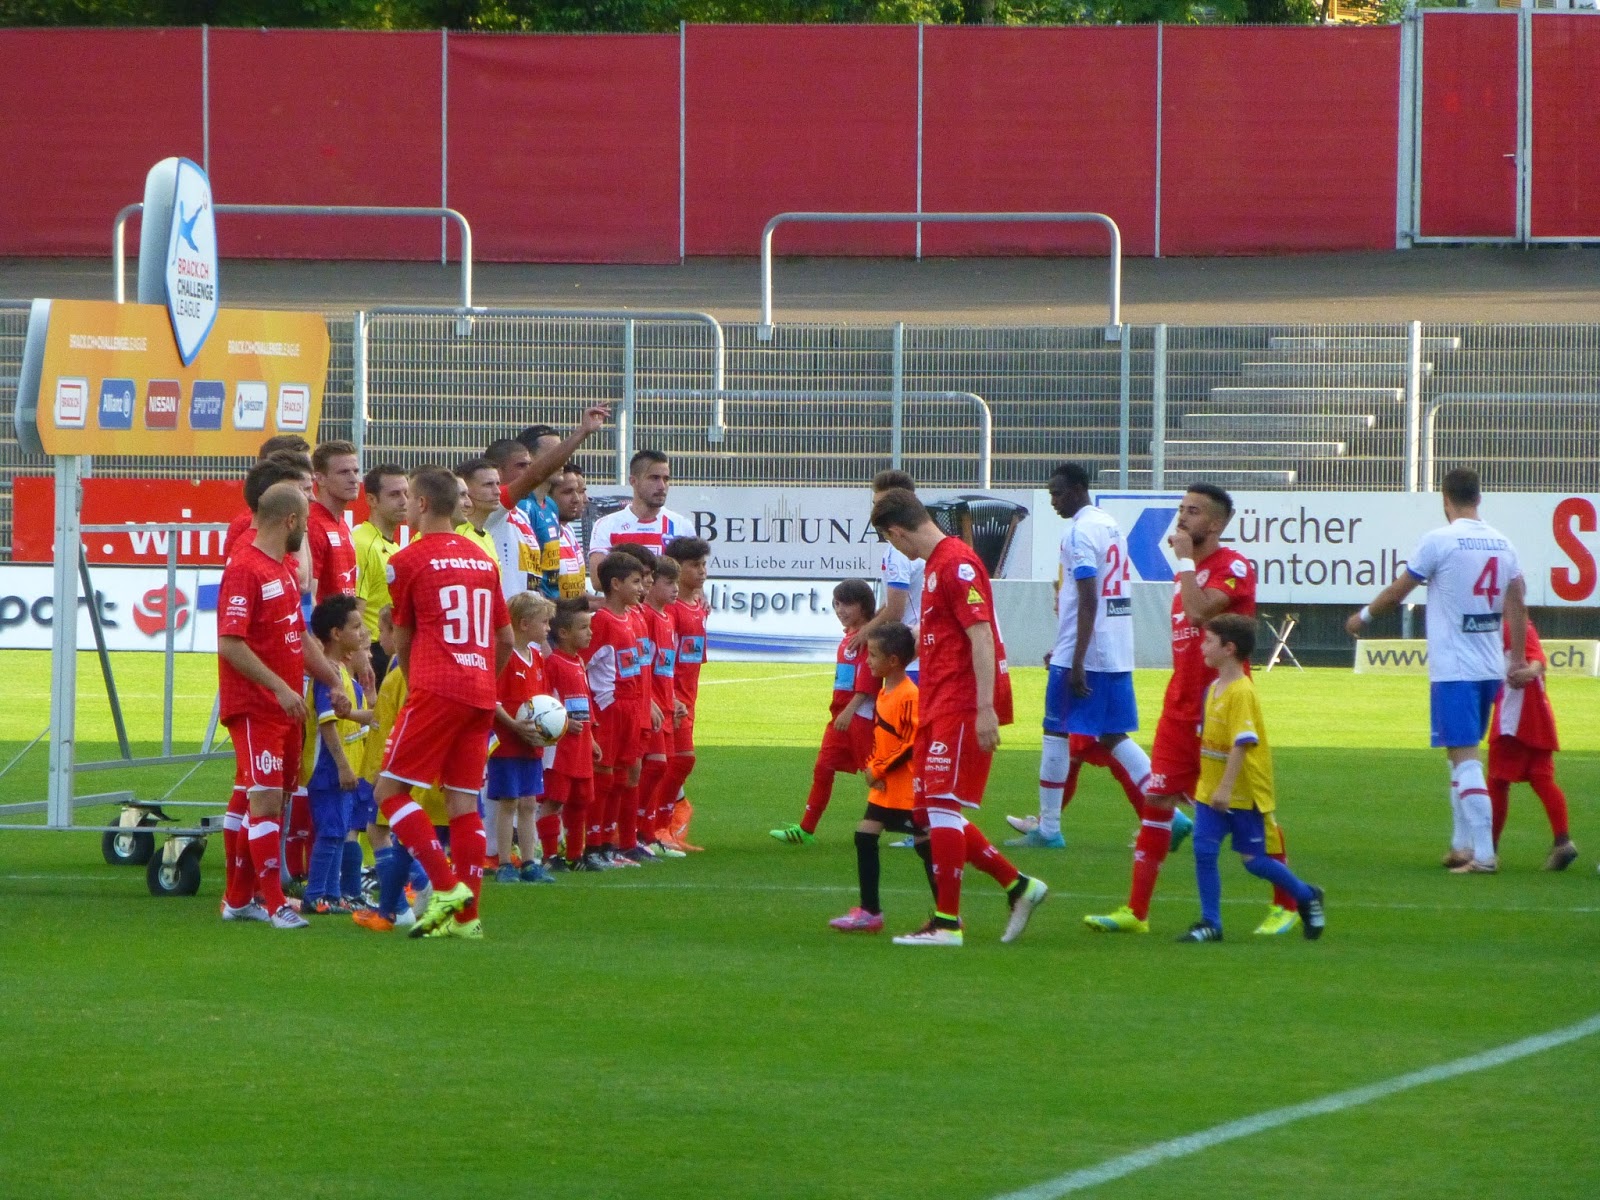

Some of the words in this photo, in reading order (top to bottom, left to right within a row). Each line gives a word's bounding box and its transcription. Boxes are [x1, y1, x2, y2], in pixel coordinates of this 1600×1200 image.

[178, 257, 209, 279] BRACK.CH
[177, 278, 214, 301] CHALLENGE
[176, 299, 201, 319] LEAGUE
[148, 395, 176, 413] NISSAN
[691, 510, 889, 544] BELTUNA
[1219, 506, 1362, 544] Zürcher
[1550, 497, 1598, 602] S
[429, 557, 494, 572] traktor
[710, 556, 740, 570] Aus
[745, 555, 787, 570] Liebe
[791, 559, 816, 570] zur
[820, 556, 872, 570] Musik.
[1472, 556, 1502, 611] 4
[438, 584, 492, 648] 30
